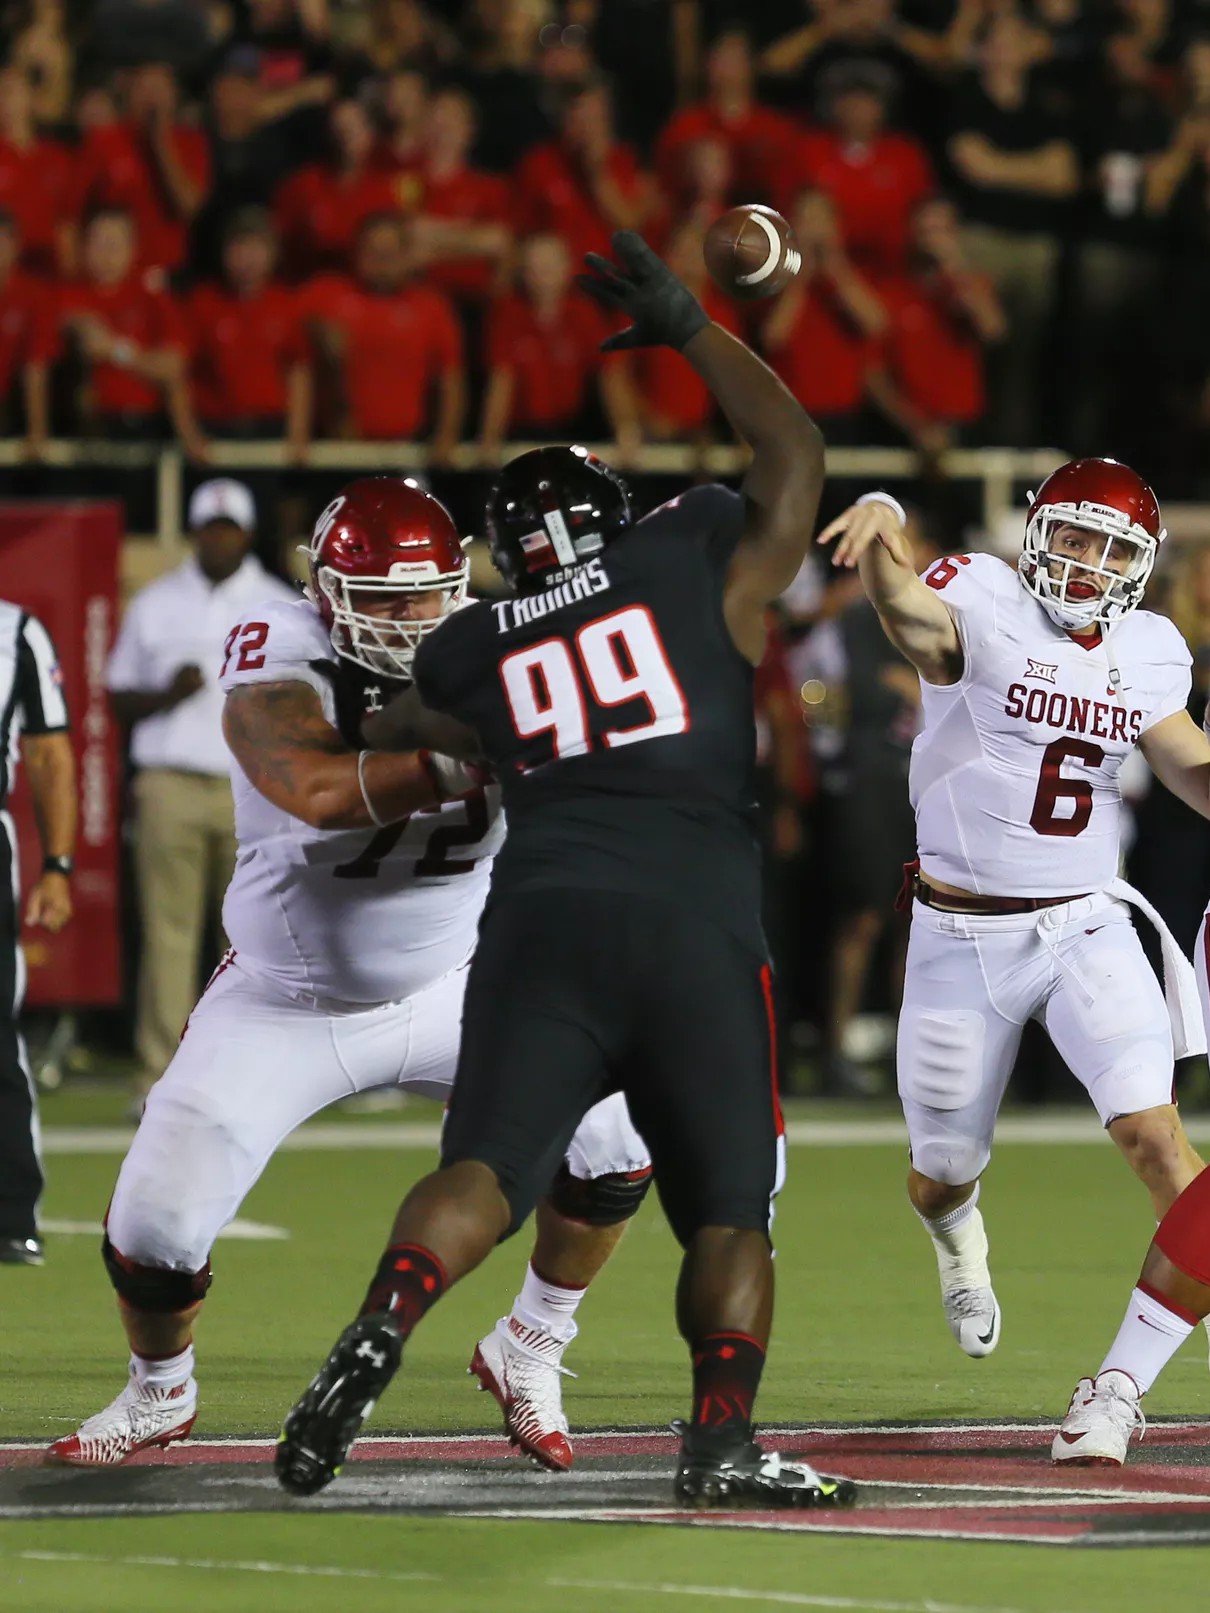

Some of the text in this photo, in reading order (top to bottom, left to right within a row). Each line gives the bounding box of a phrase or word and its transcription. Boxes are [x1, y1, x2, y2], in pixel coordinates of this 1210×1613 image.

[925, 554, 972, 591] 6
[218, 621, 270, 679] 72
[499, 603, 691, 775] 99
[1004, 683, 1143, 745] SOONERS
[1029, 736, 1106, 837] 6
[507, 1315, 529, 1339] NIKE
